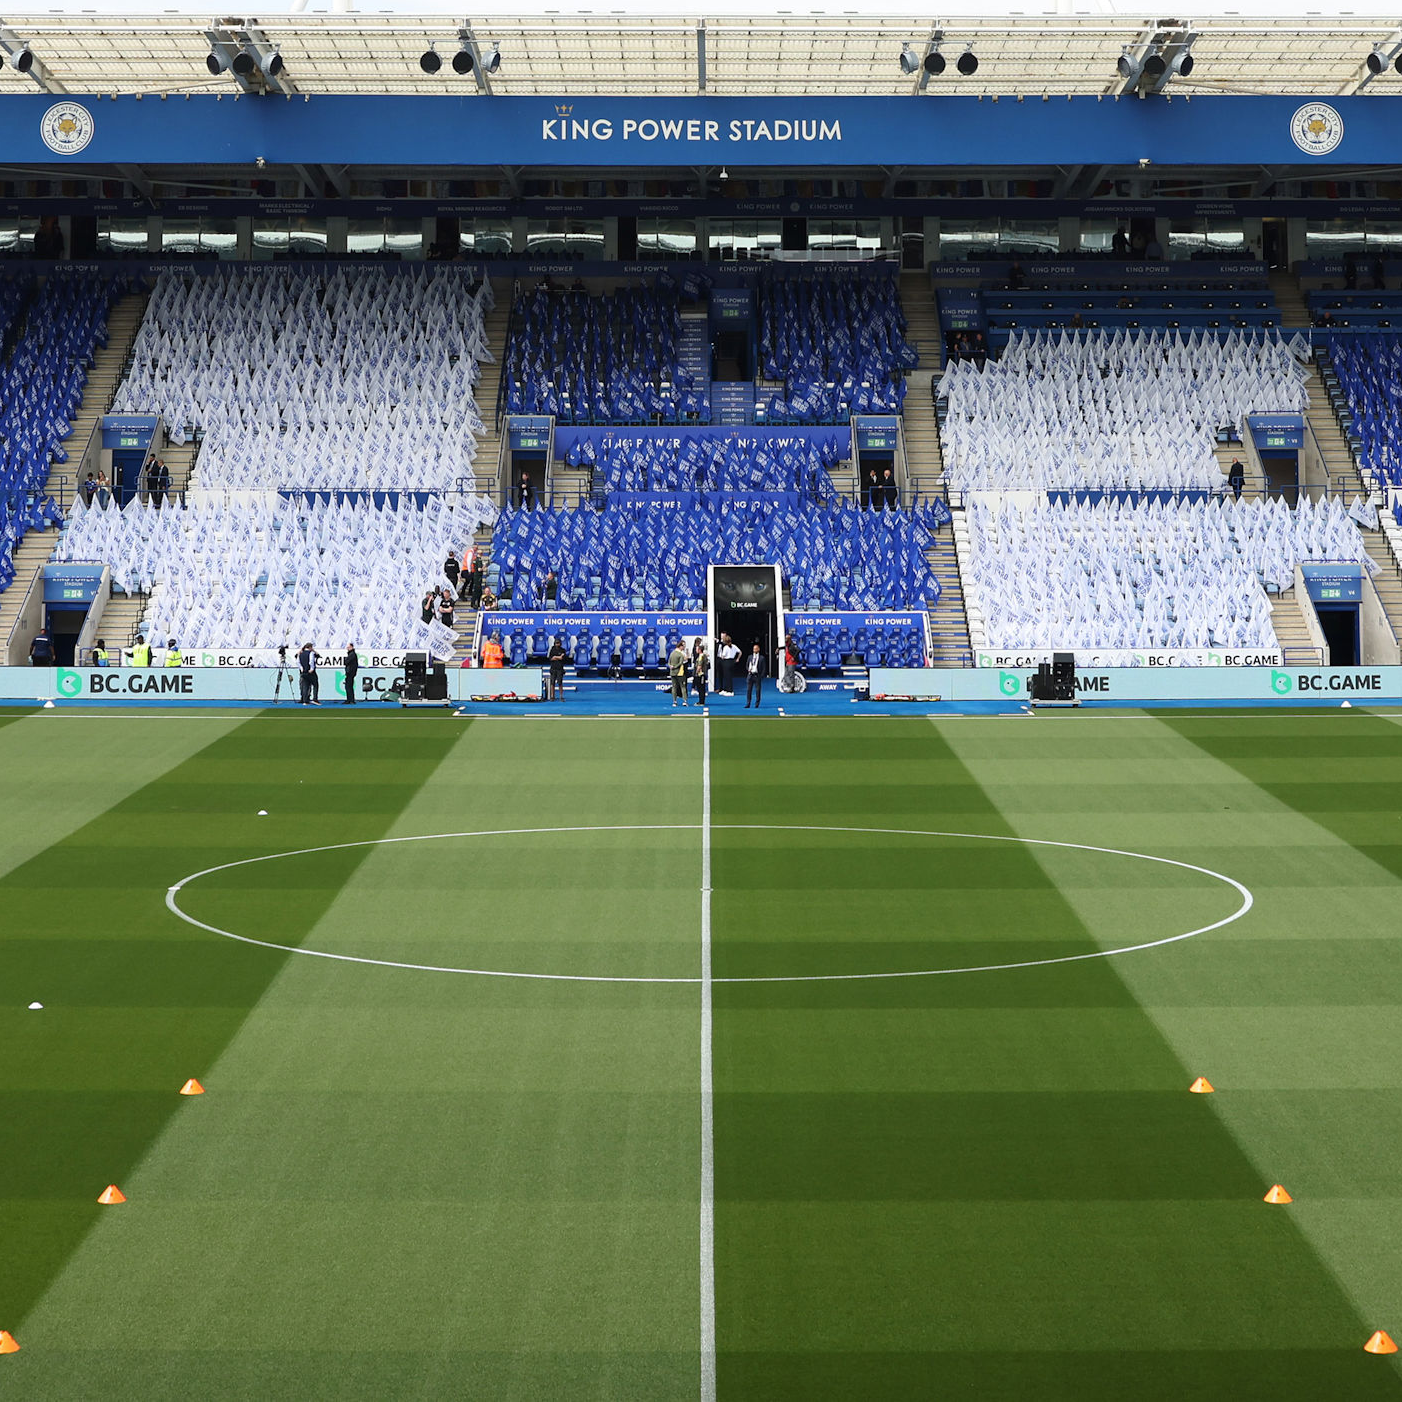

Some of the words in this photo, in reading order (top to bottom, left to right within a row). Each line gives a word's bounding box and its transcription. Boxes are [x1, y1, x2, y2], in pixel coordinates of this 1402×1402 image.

[46, 106, 79, 126] LEICESTER
[79, 111, 89, 127] CITY
[1295, 106, 1328, 127] LEICESTER
[1328, 112, 1339, 127] CITY
[46, 129, 76, 150] FOOTBALL
[76, 129, 89, 147] CLUB
[542, 119, 613, 141] KING
[623, 119, 719, 141] POWER
[729, 119, 842, 141] STADIUM
[1295, 130, 1326, 150] FOOTBALL
[1326, 130, 1339, 147] CLUB
[636, 438, 681, 449] PWR
[219, 656, 253, 666] BC.GA
[372, 656, 406, 666] BC.GA
[1225, 655, 1279, 666] BC.GAME
[89, 674, 193, 693] BC.GAME
[1298, 675, 1381, 691] BC.GAME
